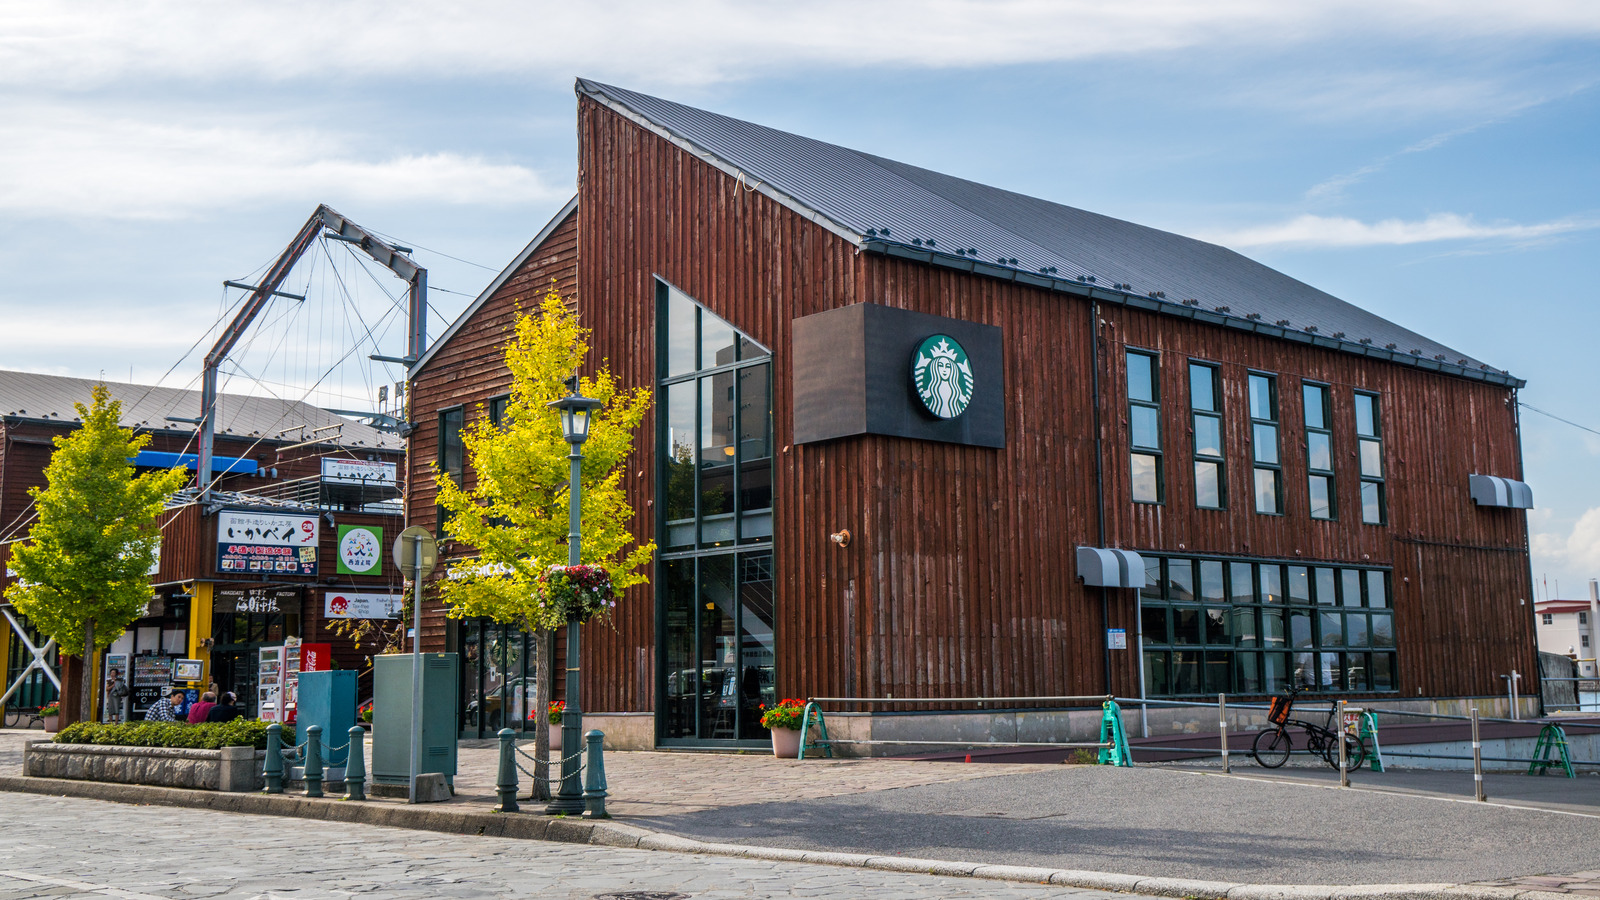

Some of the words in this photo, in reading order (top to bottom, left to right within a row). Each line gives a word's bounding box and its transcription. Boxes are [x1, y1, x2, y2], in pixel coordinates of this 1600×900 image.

[227, 527, 295, 543] いかベイ
[262, 711, 276, 720] KIRIN
